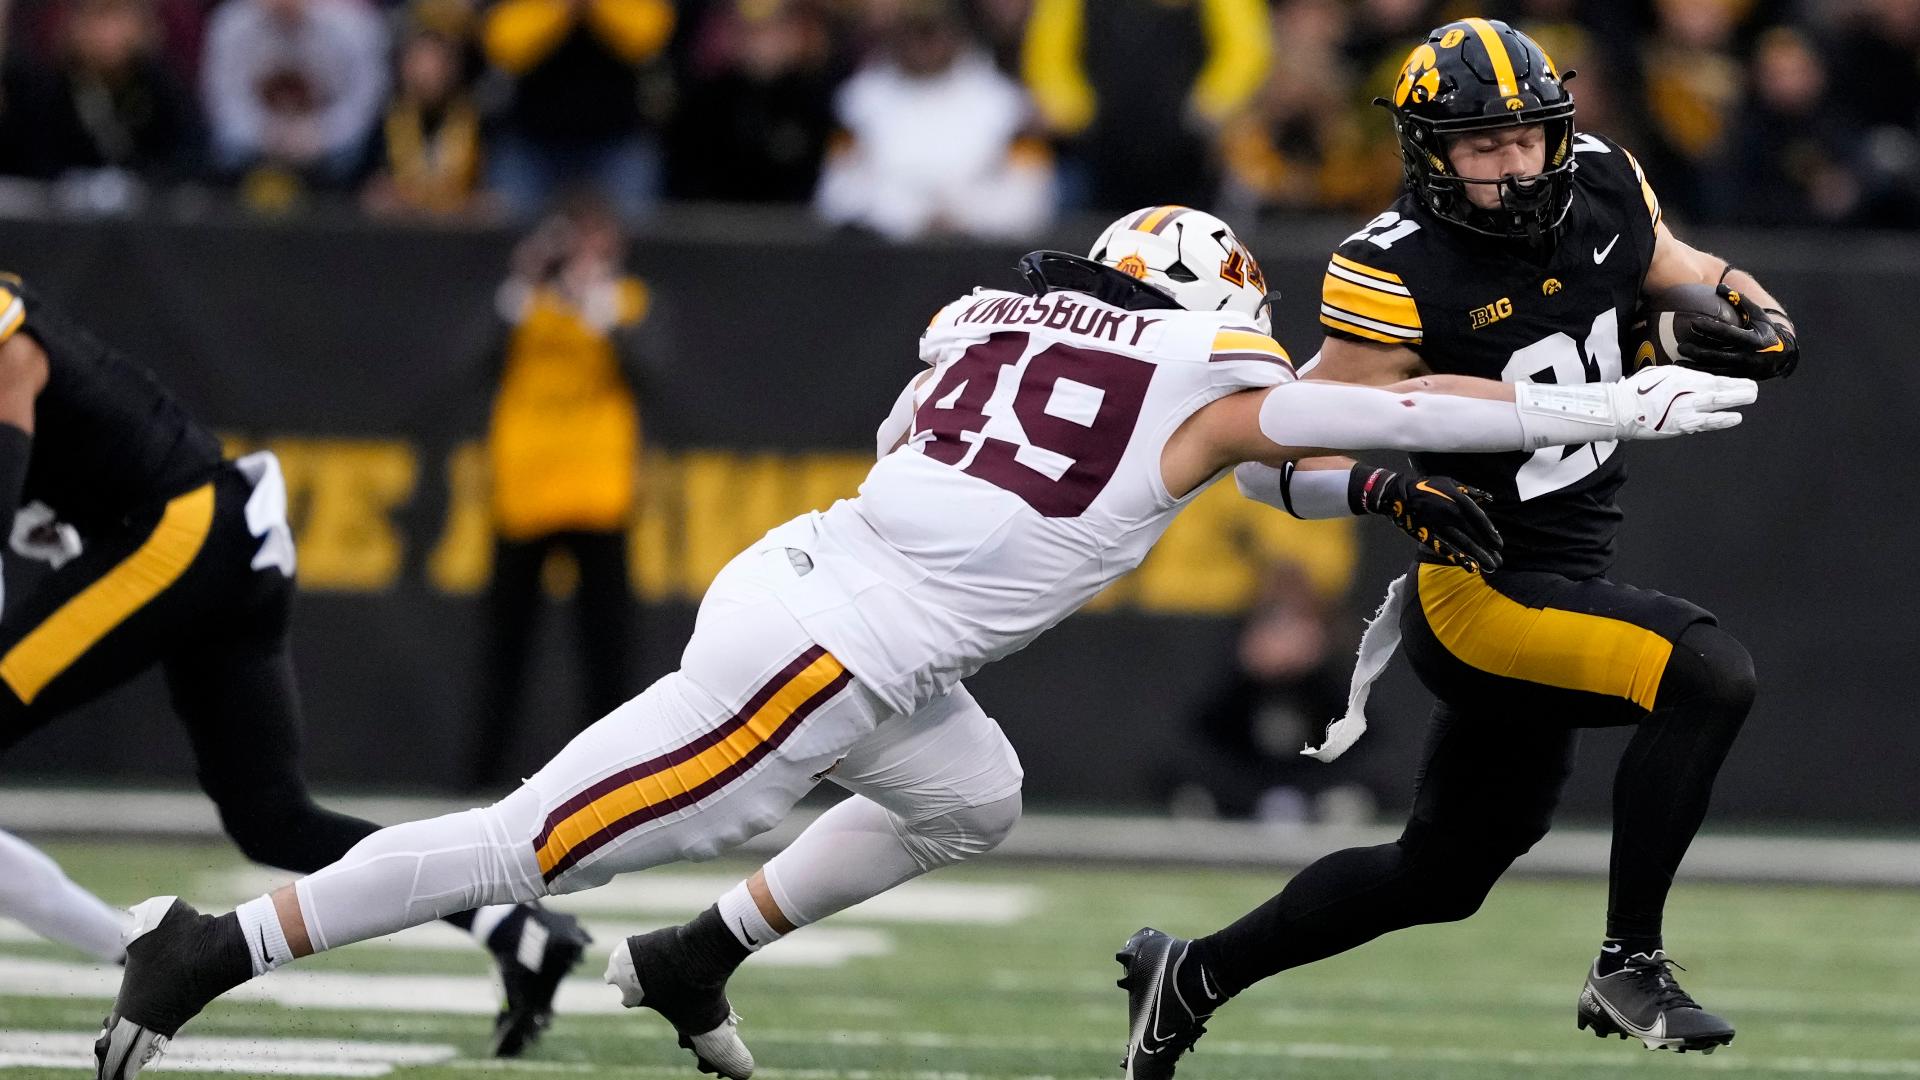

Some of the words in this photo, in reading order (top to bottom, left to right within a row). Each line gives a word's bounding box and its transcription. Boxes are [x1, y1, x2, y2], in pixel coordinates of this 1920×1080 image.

[1339, 211, 1421, 250] 21
[954, 297, 1168, 346] KINGSBURY
[914, 331, 1157, 518] 49
[1501, 307, 1623, 502] 21
